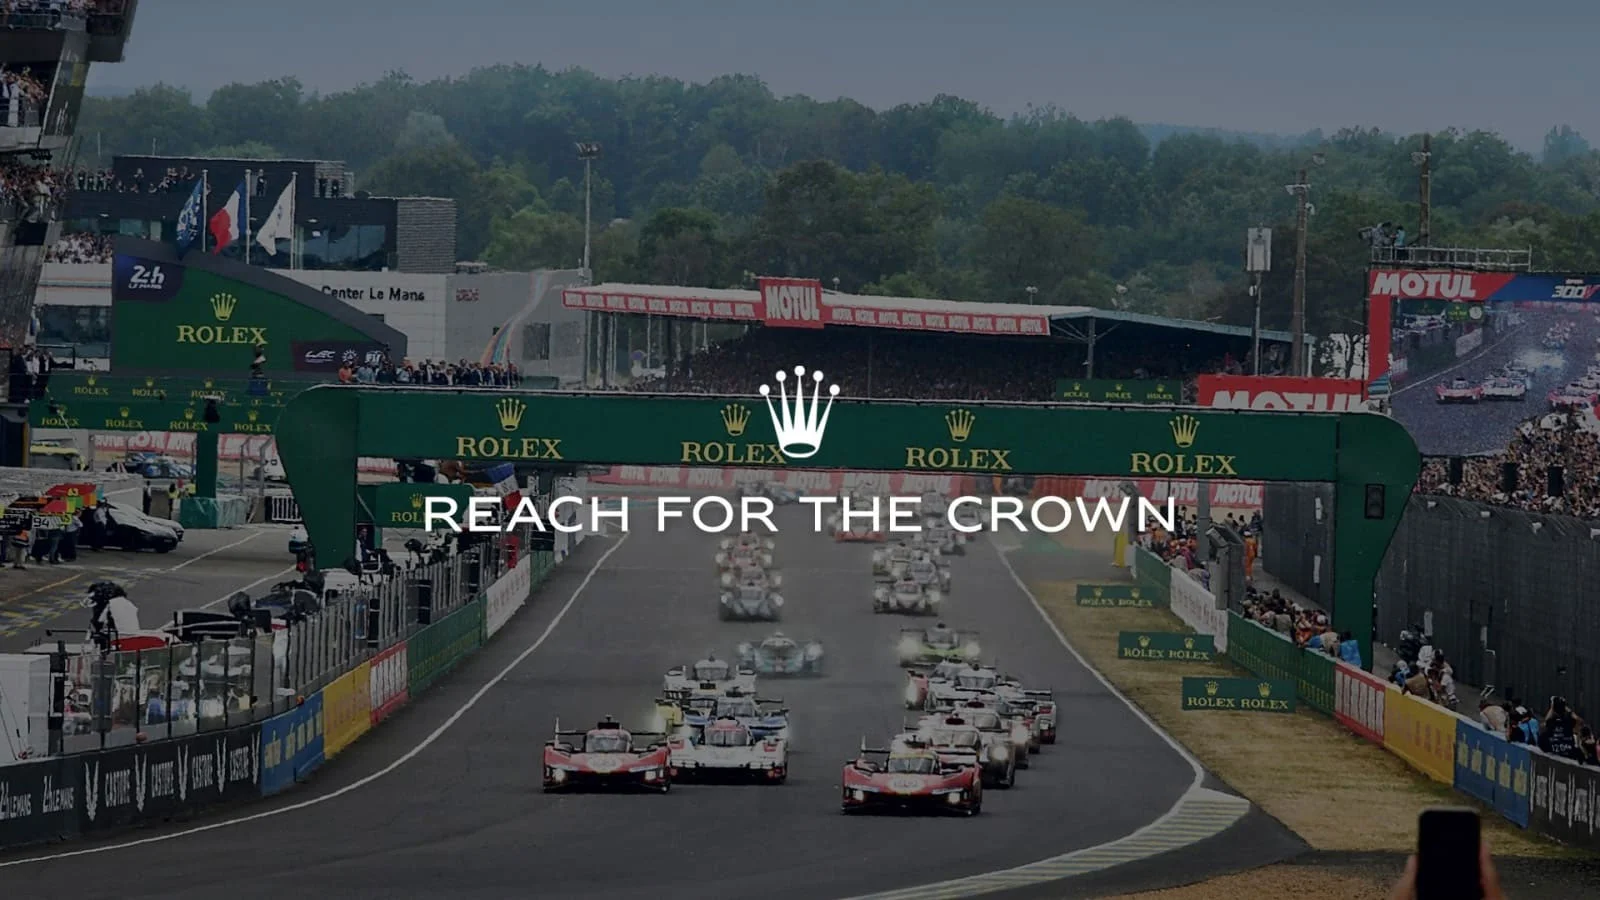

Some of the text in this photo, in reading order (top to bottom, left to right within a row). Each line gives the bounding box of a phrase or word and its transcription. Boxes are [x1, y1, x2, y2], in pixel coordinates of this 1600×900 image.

[1372, 271, 1476, 298] MOTUL
[369, 287, 384, 300] Le
[390, 287, 425, 301] Mans
[1552, 285, 1600, 299] 300V
[765, 284, 820, 321] MOTUL
[177, 325, 269, 345] ROLEX
[74, 386, 109, 396] ROLEX
[132, 388, 168, 398] ROLEX
[41, 416, 80, 426] ROLEX
[105, 418, 144, 430] ROLEX
[170, 420, 209, 431] ROLEX
[234, 422, 272, 433] ROLEX
[456, 436, 563, 460] ROLEX
[680, 441, 787, 465] ROLEX
[905, 446, 1013, 471] ROLEX
[1130, 452, 1238, 476] ROLEX
[1213, 483, 1263, 504] MOTUL
[1118, 598, 1153, 608] ROLEX
[1123, 648, 1210, 661] ROLEX ROLEX
[1187, 696, 1289, 711] ROLEX ROLEX
